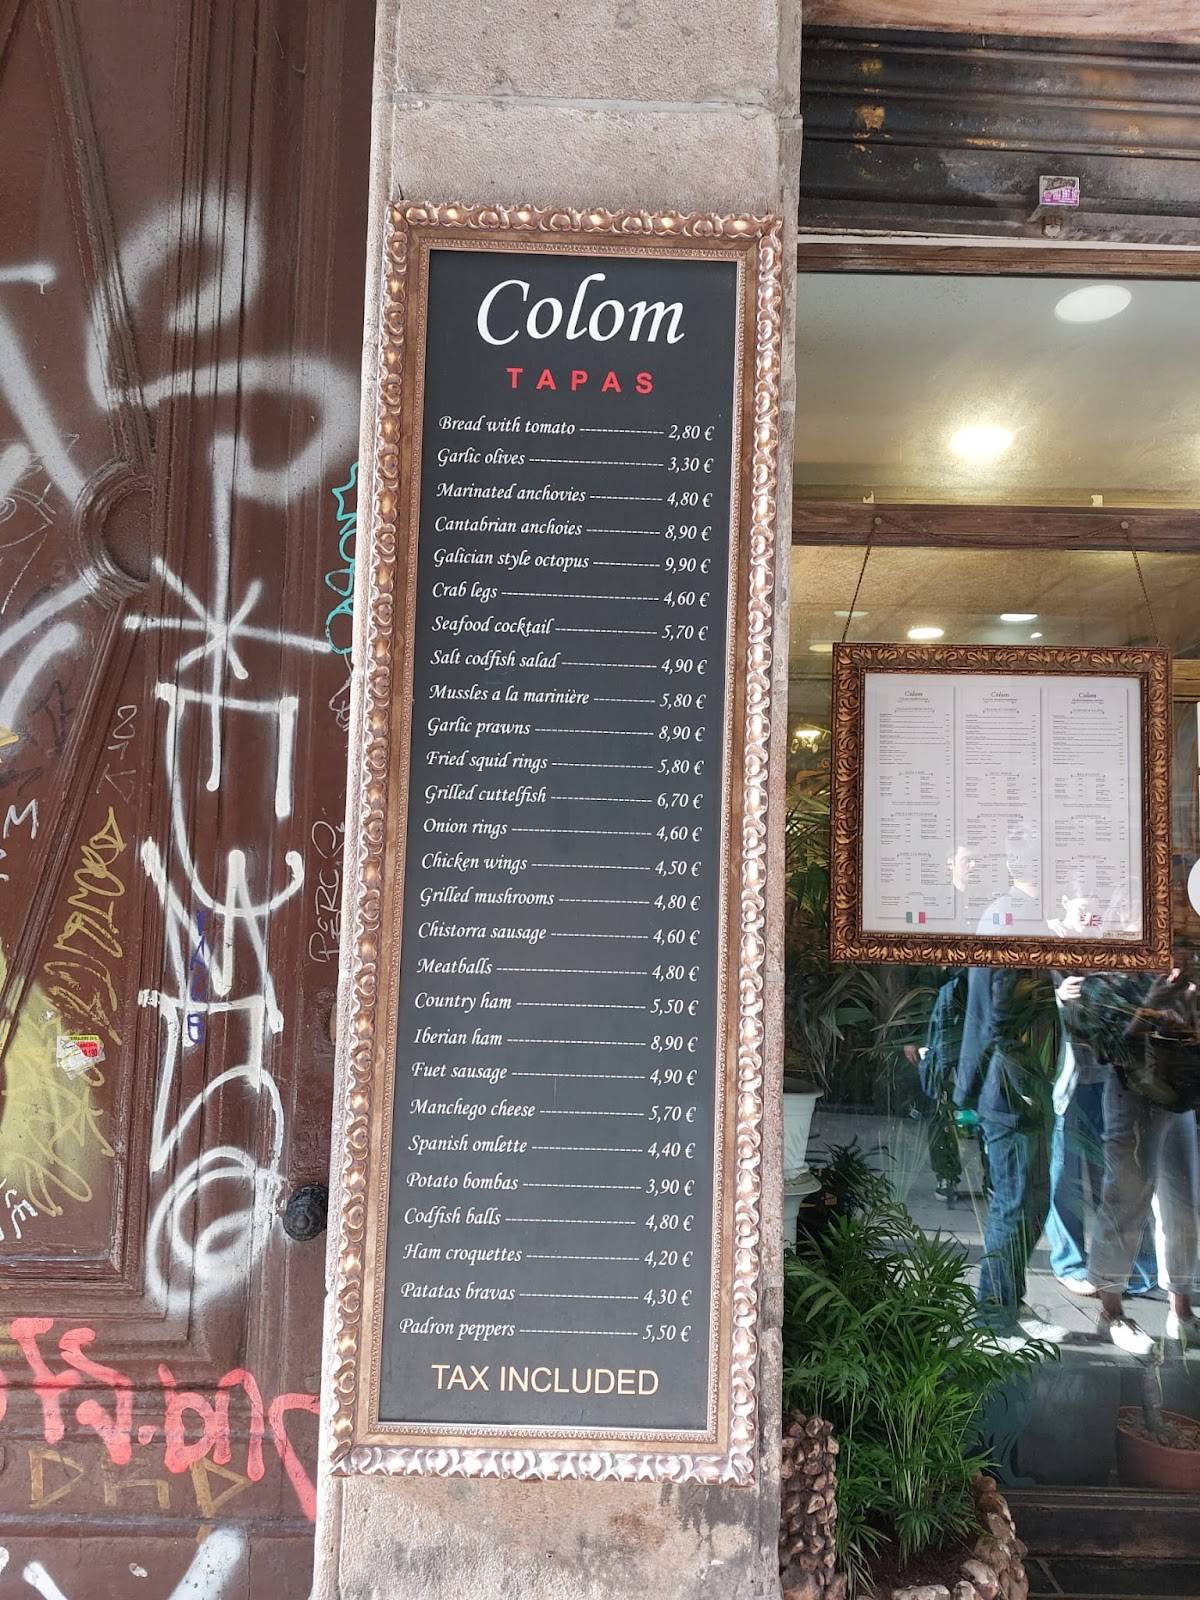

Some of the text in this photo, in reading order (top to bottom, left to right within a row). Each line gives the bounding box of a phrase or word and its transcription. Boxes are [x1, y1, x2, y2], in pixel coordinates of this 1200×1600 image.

[477, 272, 685, 345] Colom
[506, 367, 654, 394] TAPAS
[438, 414, 715, 442] Bread with tomato 2,80 €
[437, 446, 714, 474] Garlic olives 3,30 €
[435, 482, 713, 509] Marinated anchovies 4,80 €
[434, 515, 712, 542] Cantabrian anchoies 8,90 €
[433, 546, 712, 574] Galician style octopus 9,90 €
[432, 580, 711, 608] Crab legs 4,60 €
[431, 614, 709, 642] Seafood cocktail 5,70 €
[429, 647, 708, 676] Salt codfish salad 4,90 €
[428, 683, 707, 710] Mussles a la marinière 5,80 €
[427, 715, 706, 743] Garlic prawns 8,90 €
[426, 749, 705, 776] Fried squid rings 5,80 €
[424, 783, 704, 810] Grilled cuttelfish 6,70 €
[423, 817, 703, 843] Onion rings 4,60 €
[421, 850, 702, 878] Chicken wings 4,50 €
[419, 885, 701, 912] Grilled mushrooms 4,80 €
[418, 919, 701, 946] Chistorra sausage 4,60 €
[415, 956, 700, 982] Meatballs 4,80 €
[414, 991, 699, 1016] Country ham 5,50 €
[413, 1026, 699, 1053] Iberian ham 8,90 €
[411, 1061, 698, 1087] Fuet sausage 4,90 €
[409, 1097, 697, 1124] Manchego cheese 5,70 €
[407, 1133, 696, 1160] Spanish omlette 4,40 €
[406, 1171, 696, 1197] Potato bombas 3,90 €
[404, 1205, 695, 1233] Codfish balls 4,80 €
[402, 1242, 694, 1269] Ham croquettes 4,20 €
[400, 1281, 693, 1307] Patatas bravas 4,30 €
[399, 1316, 692, 1343] Padron peppers 5,50 €
[431, 1362, 660, 1397] TAX INCLUDED
